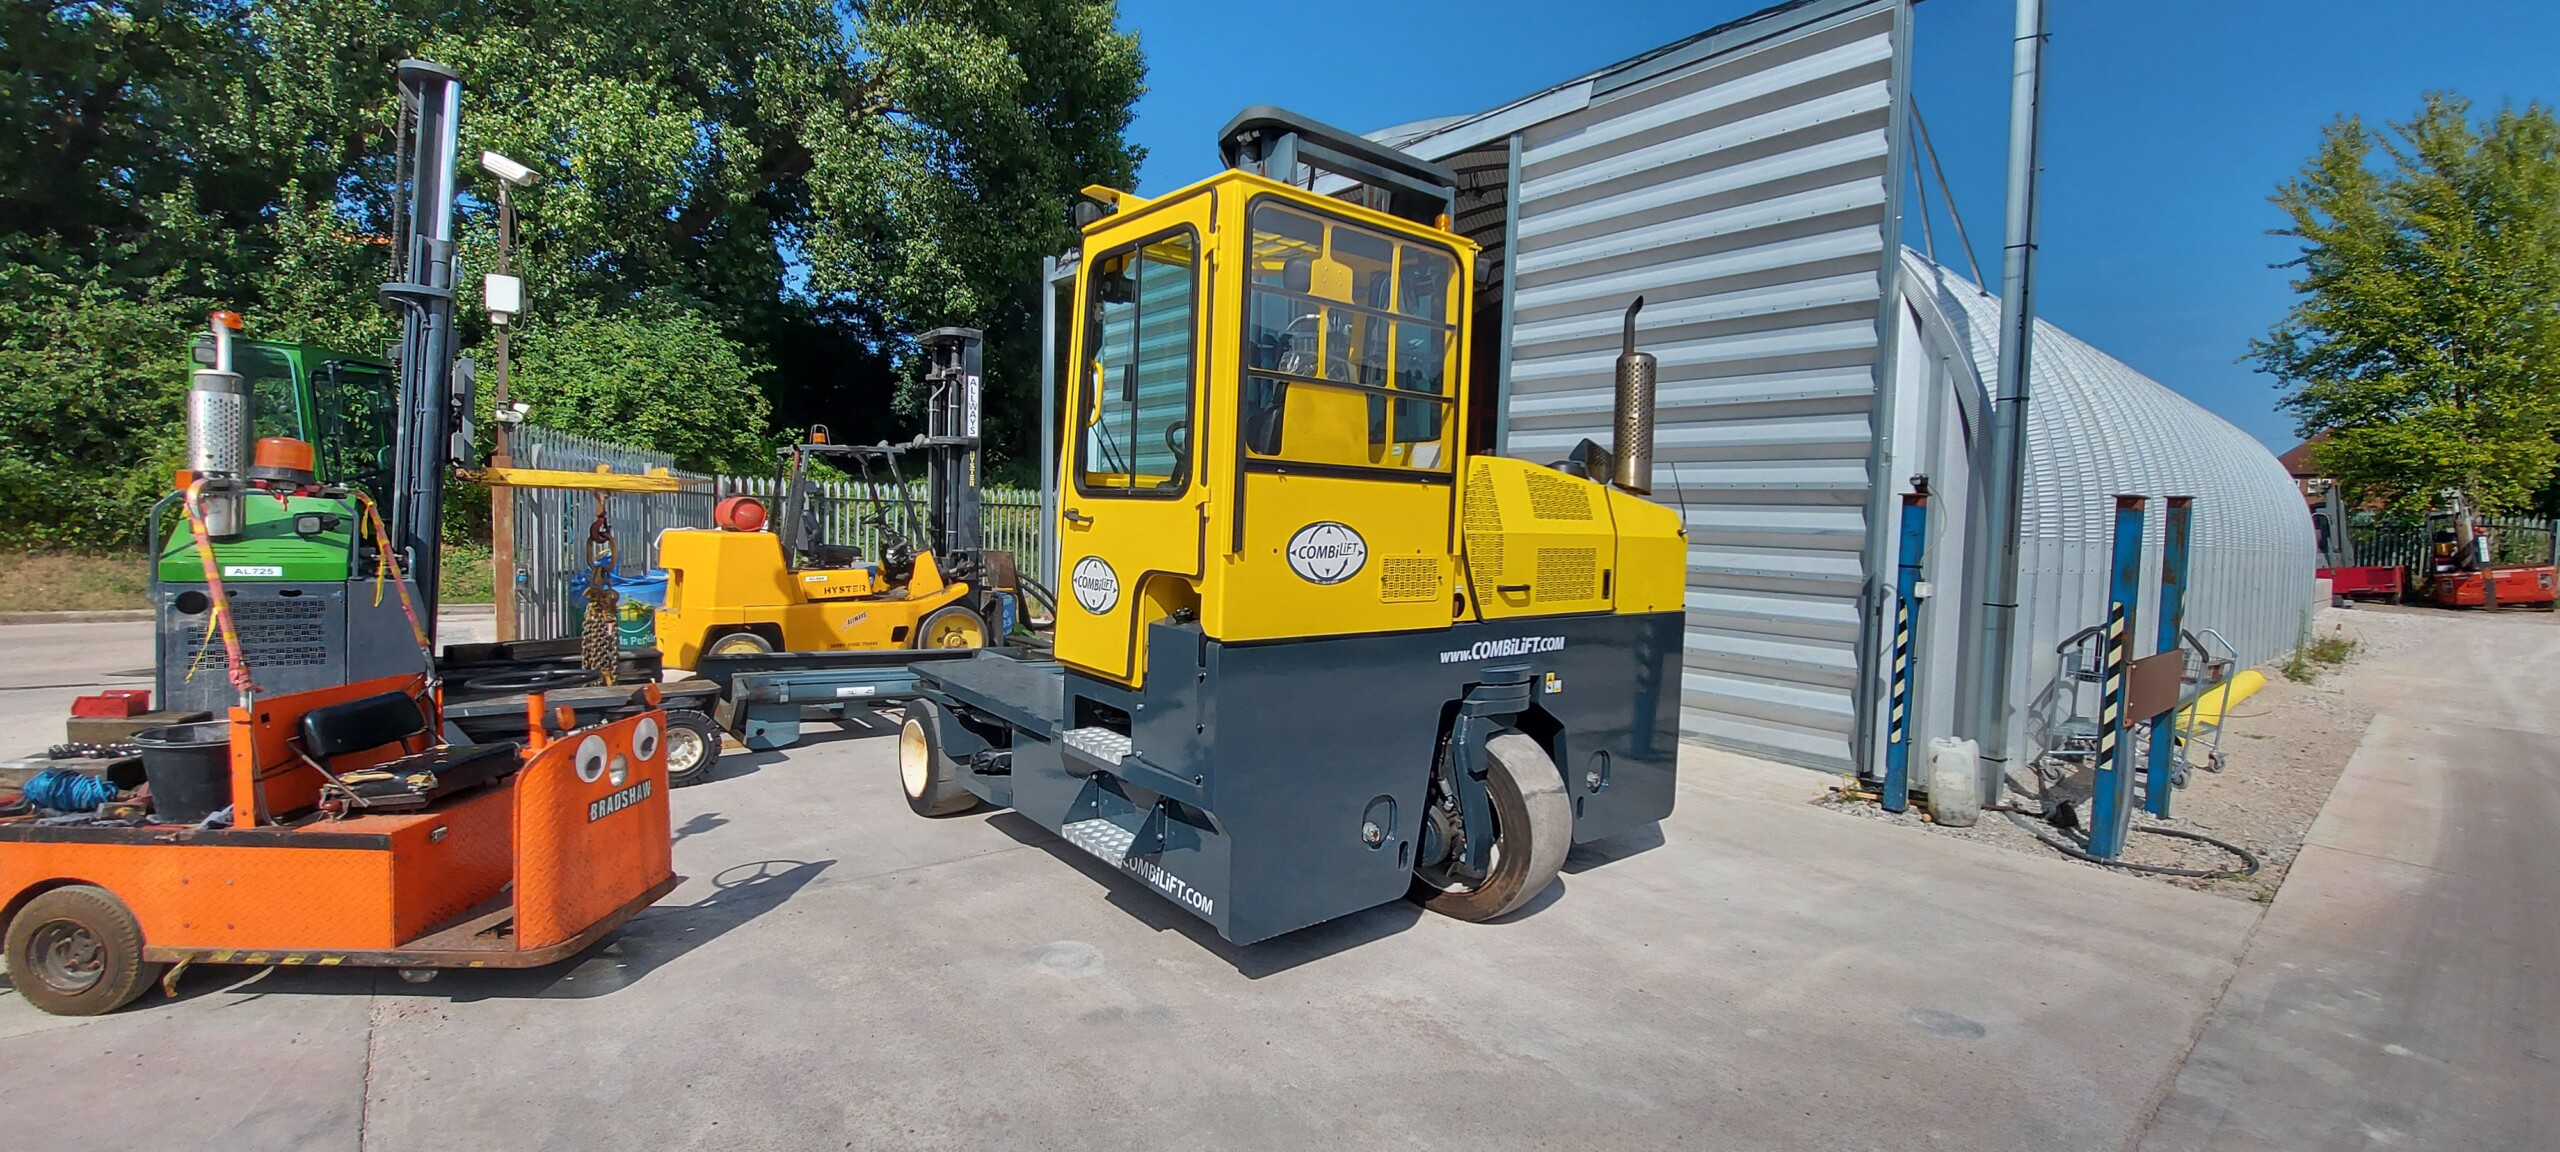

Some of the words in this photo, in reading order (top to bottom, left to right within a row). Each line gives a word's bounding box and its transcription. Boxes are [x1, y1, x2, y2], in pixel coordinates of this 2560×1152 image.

[968, 377, 978, 436] ALLWAYS
[1298, 541, 1359, 560] COMBiLiFT
[824, 585, 866, 594] HYSTER
[590, 780, 652, 821] BRADSHAW
